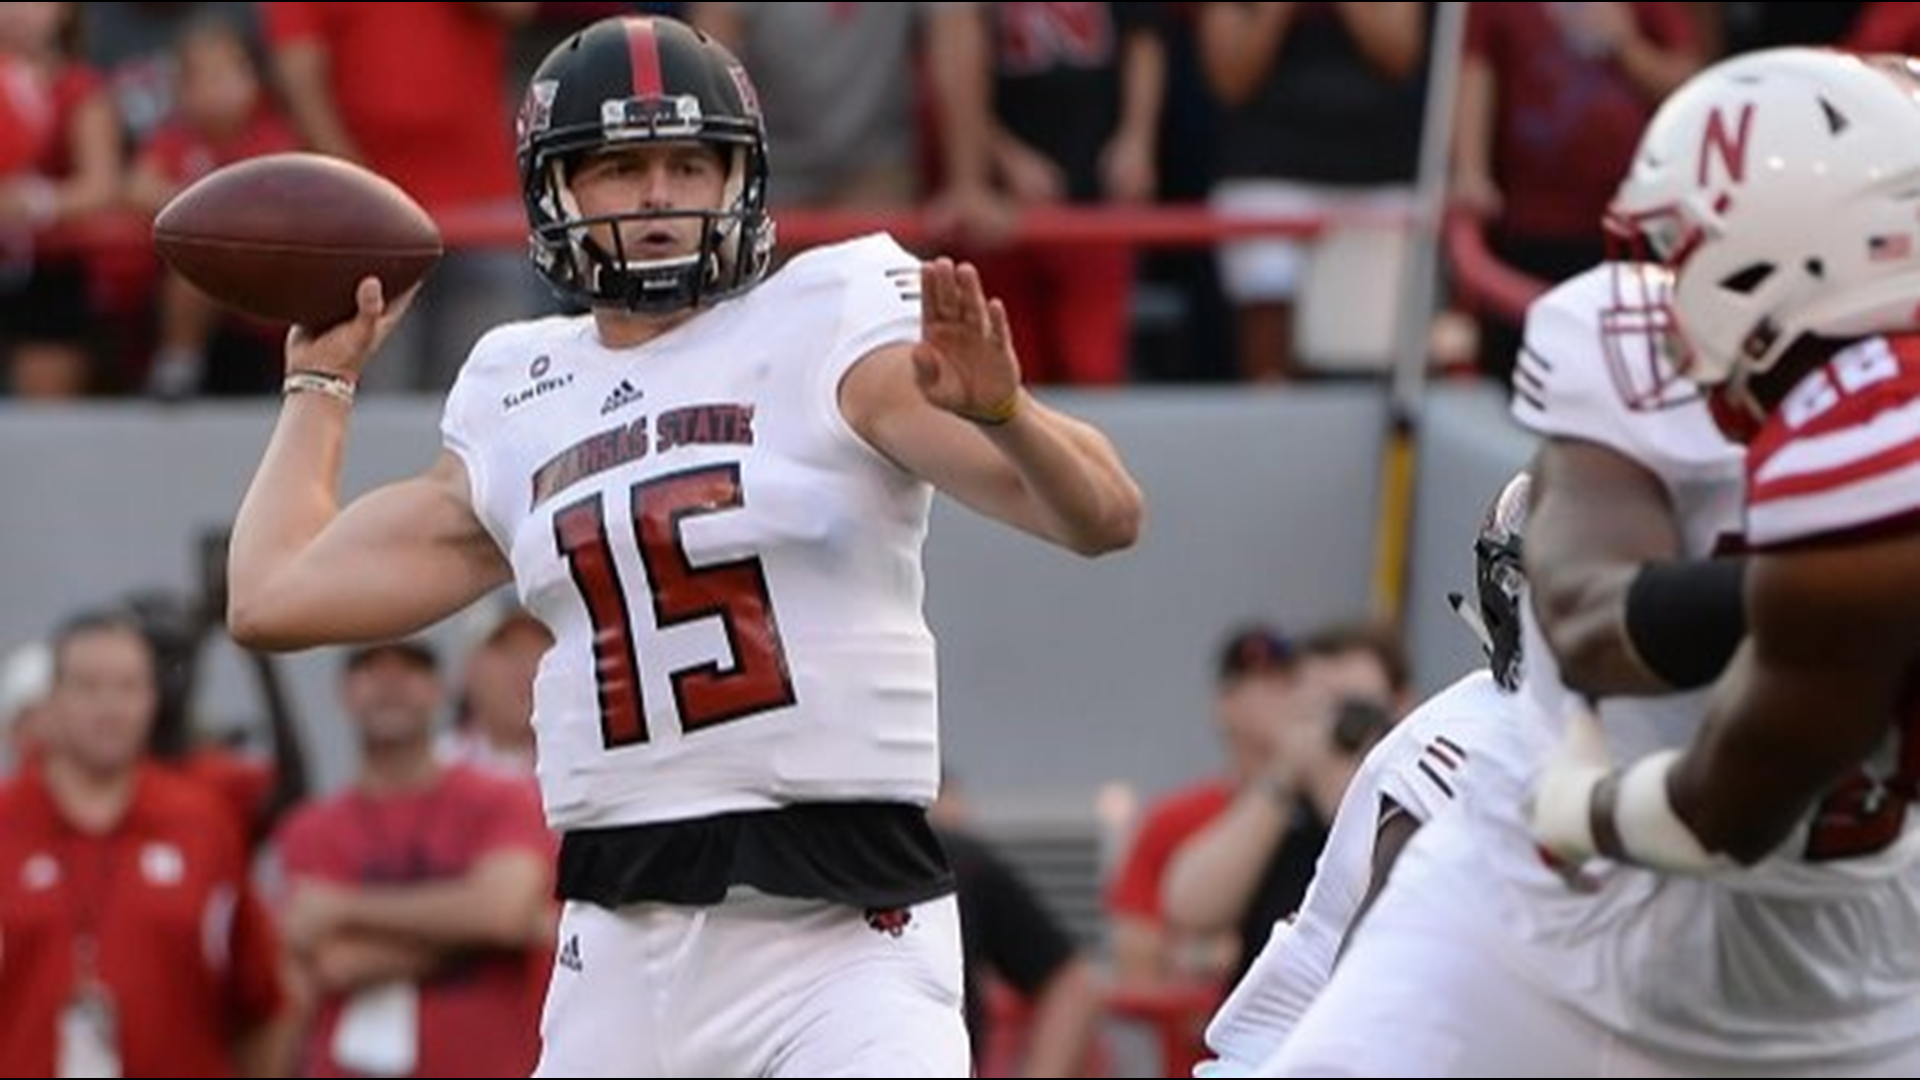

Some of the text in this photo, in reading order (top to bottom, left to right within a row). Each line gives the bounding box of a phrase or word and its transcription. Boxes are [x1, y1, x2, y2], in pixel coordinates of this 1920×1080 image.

[1698, 103, 1756, 187] N
[656, 403, 755, 454] STATE
[553, 462, 797, 750] 15
